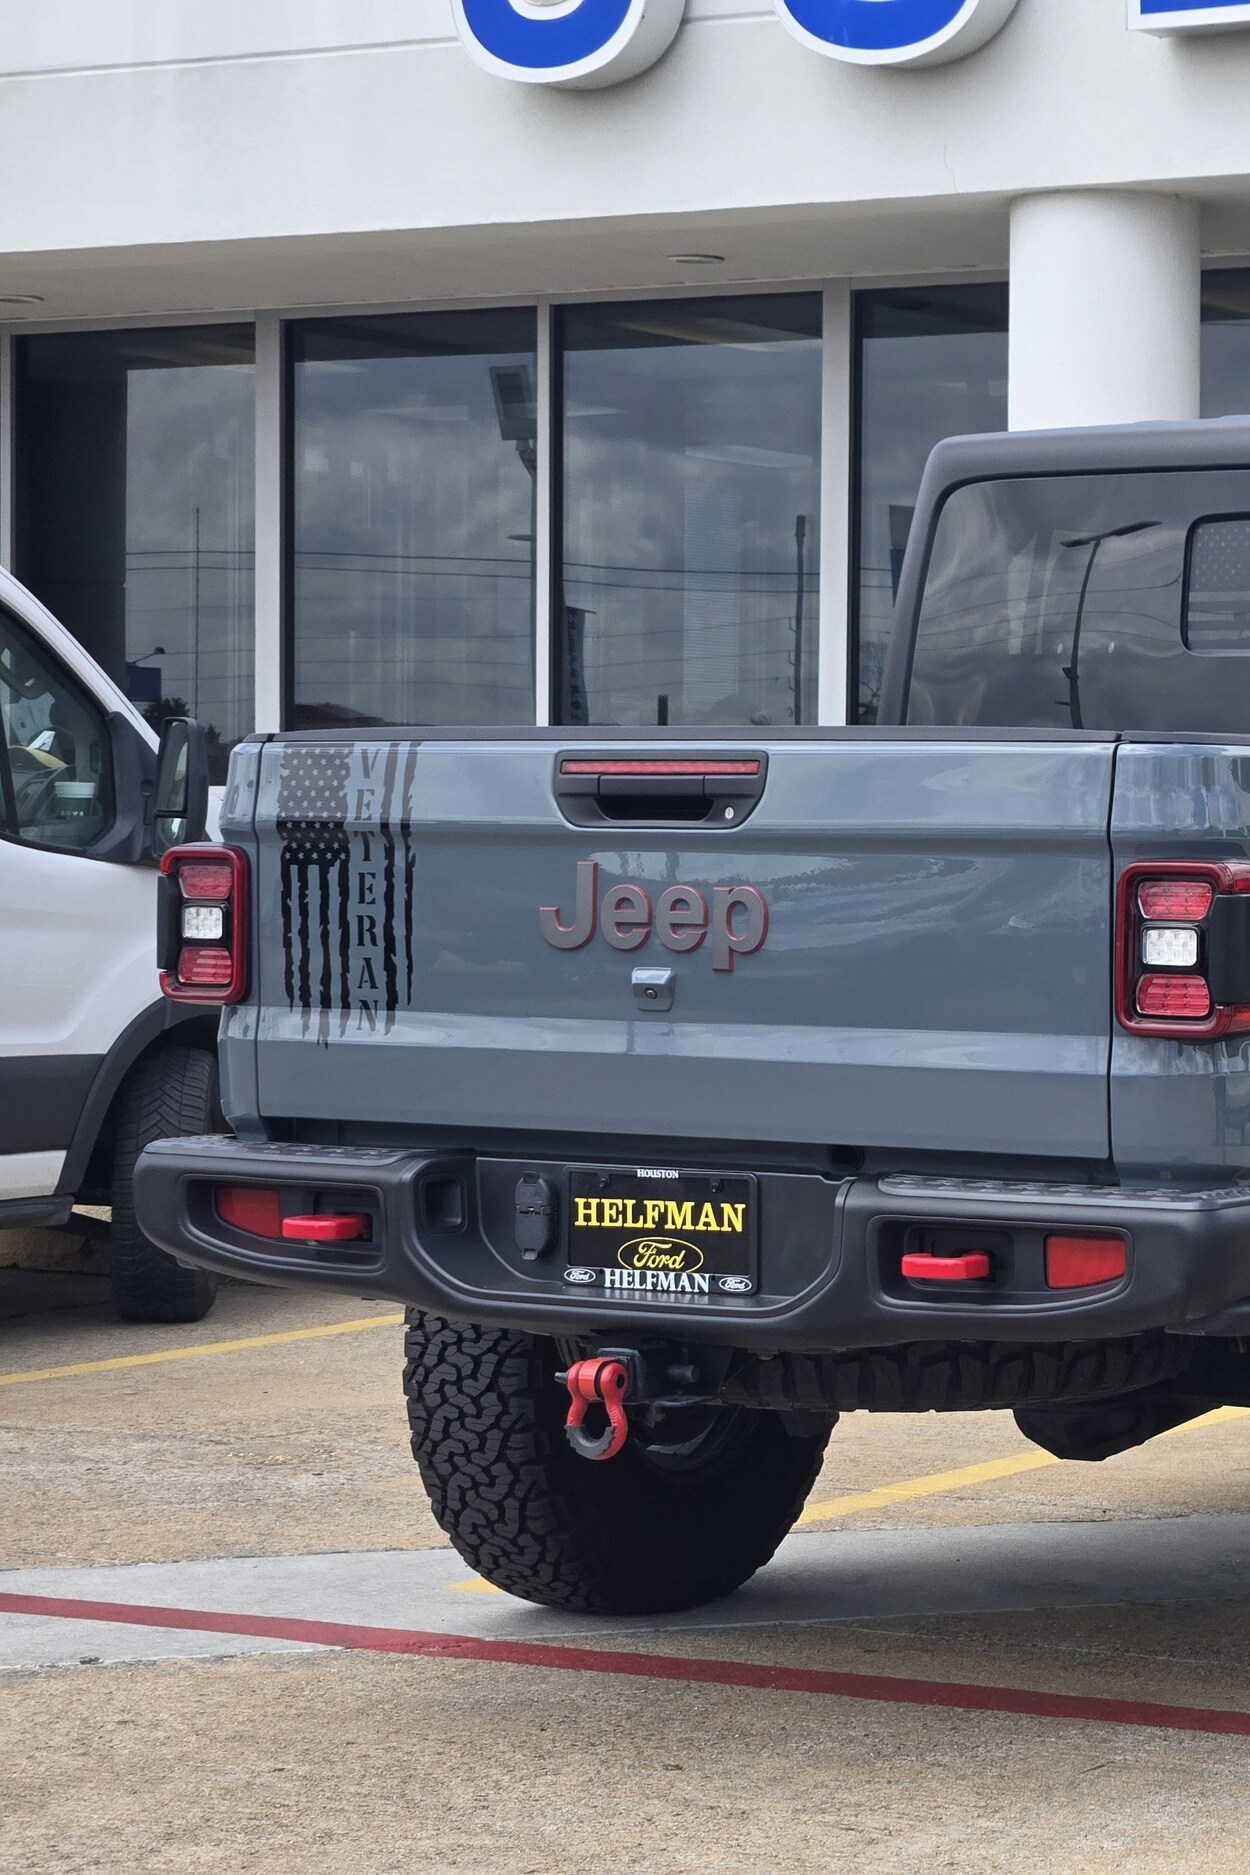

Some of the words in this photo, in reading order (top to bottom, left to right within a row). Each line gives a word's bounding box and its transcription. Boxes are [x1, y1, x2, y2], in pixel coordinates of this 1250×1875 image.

[353, 747, 380, 1032] VETERAN
[538, 858, 769, 973] Jeep
[636, 1168, 680, 1179] HOUSTON
[574, 1197, 747, 1232] HELFMAN
[633, 1241, 687, 1270] Ford
[603, 1268, 711, 1294] HELFMAN
